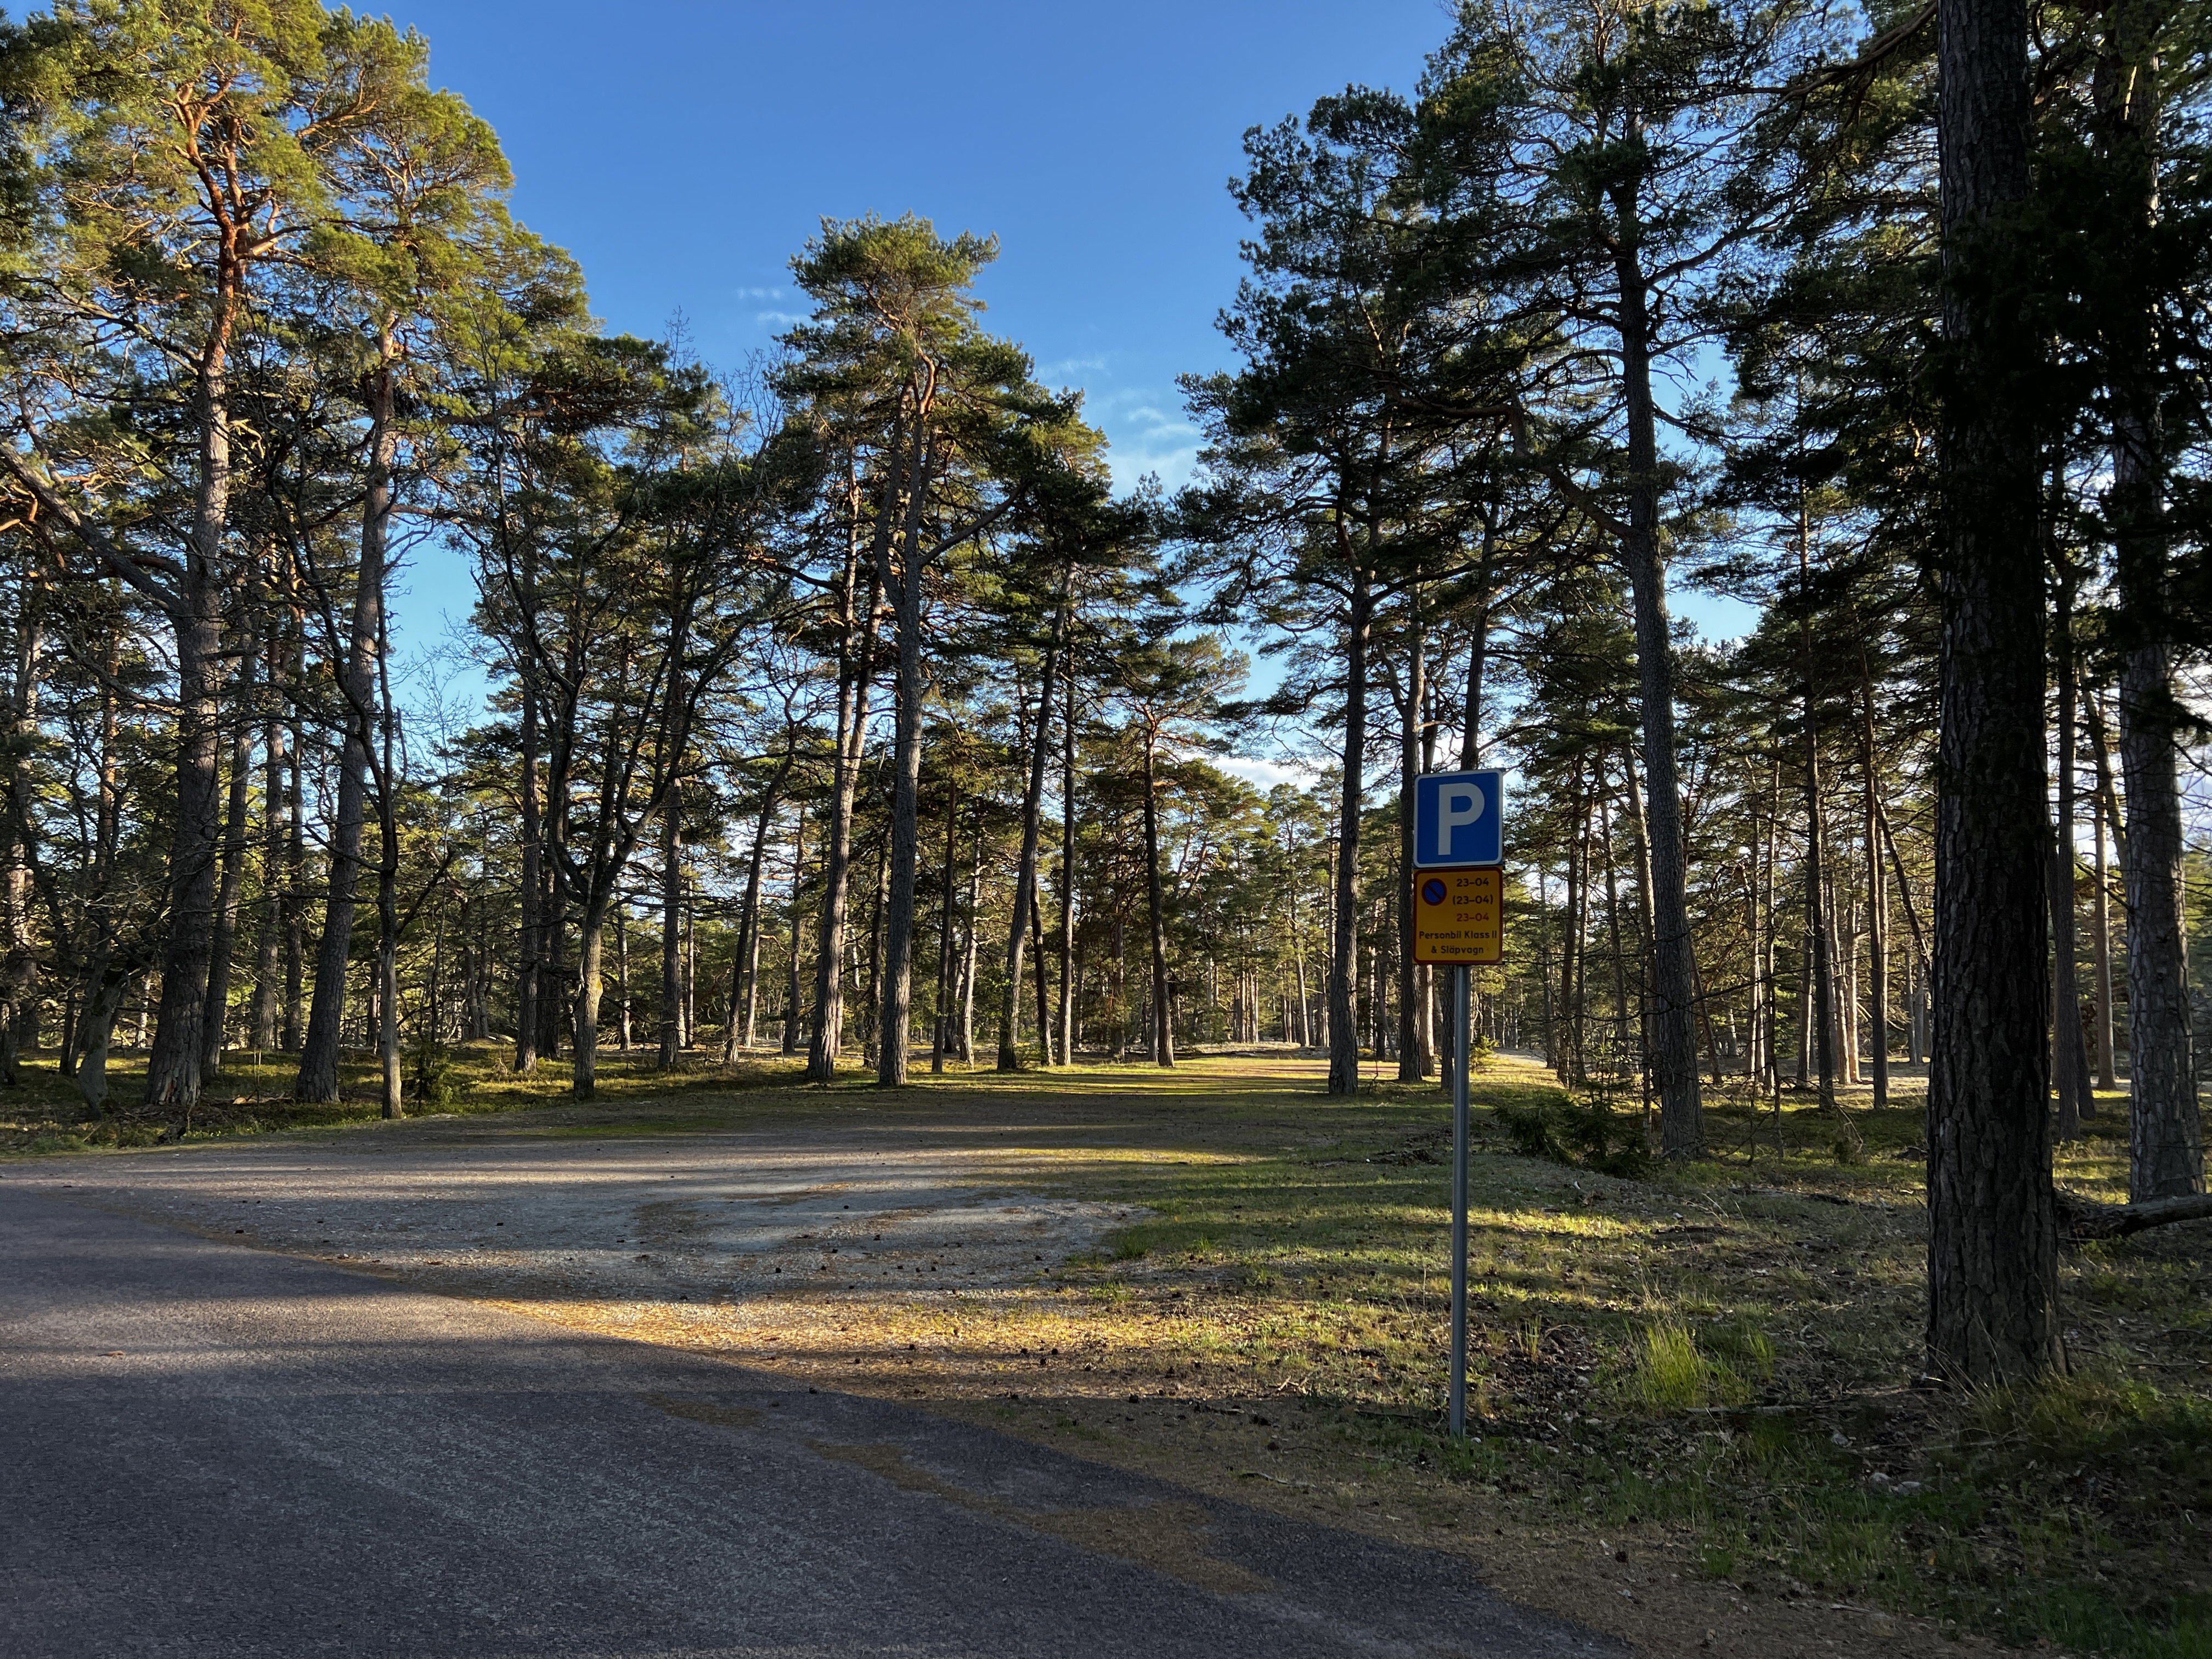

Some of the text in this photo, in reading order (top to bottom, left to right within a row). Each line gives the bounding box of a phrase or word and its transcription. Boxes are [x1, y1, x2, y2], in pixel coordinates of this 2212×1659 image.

[1438, 782, 1485, 856] P
[1456, 878, 1489, 887] 23-04
[1452, 894, 1493, 905] (23-04)
[1456, 912, 1489, 922] 23-04
[1419, 930, 1462, 939] Personbil
[1464, 930, 1490, 939] Klass
[1431, 945, 1484, 956] & Släpvagn
